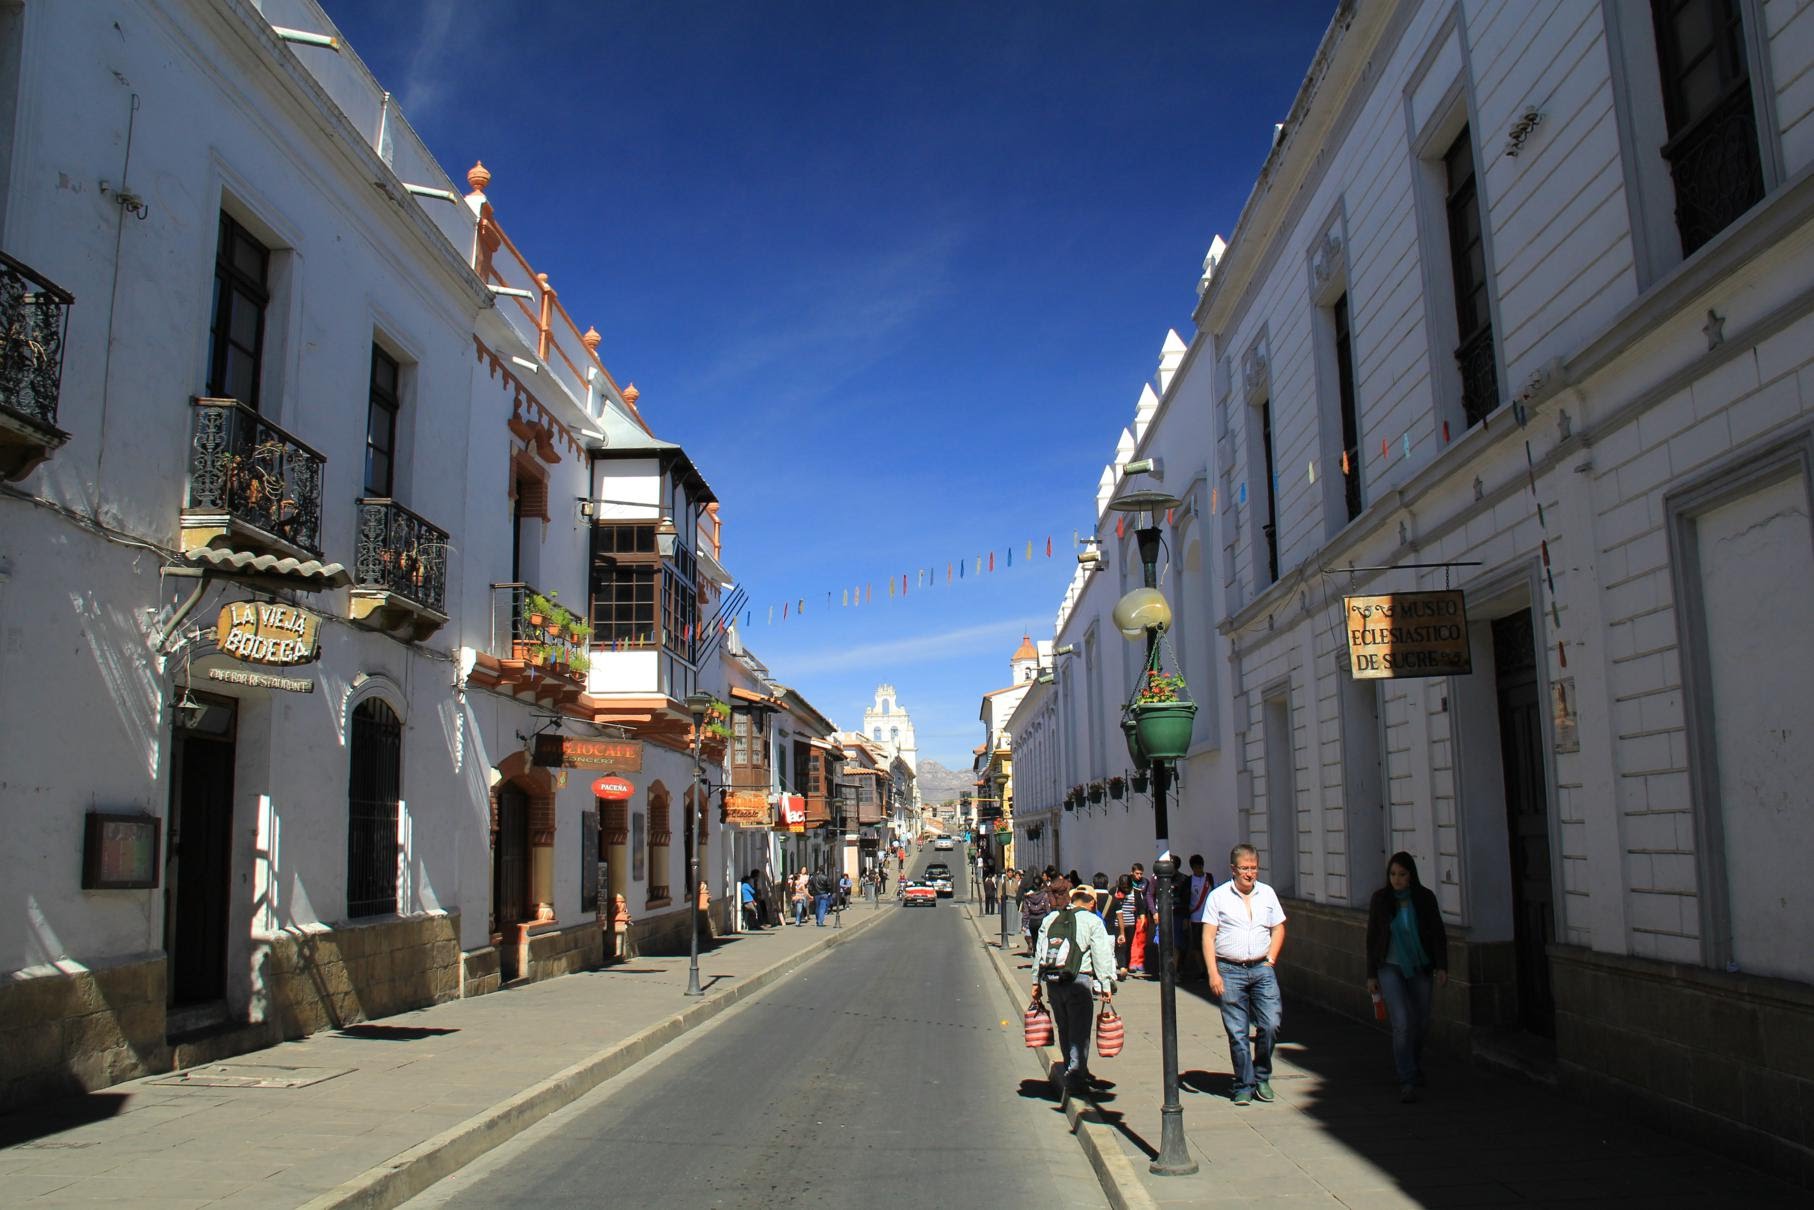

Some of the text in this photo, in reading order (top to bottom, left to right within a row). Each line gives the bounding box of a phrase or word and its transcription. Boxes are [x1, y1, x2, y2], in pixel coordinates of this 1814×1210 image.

[1400, 600, 1457, 617] MUSEO
[231, 605, 307, 635] LA VIEJA
[225, 627, 309, 661] BODEGA
[1351, 625, 1461, 646] ECLESIASTICO
[1356, 651, 1439, 671] DE SUCRE
[231, 672, 248, 684] BAR
[249, 674, 306, 692] RESTAURANT
[601, 783, 628, 792] PACEÑA
